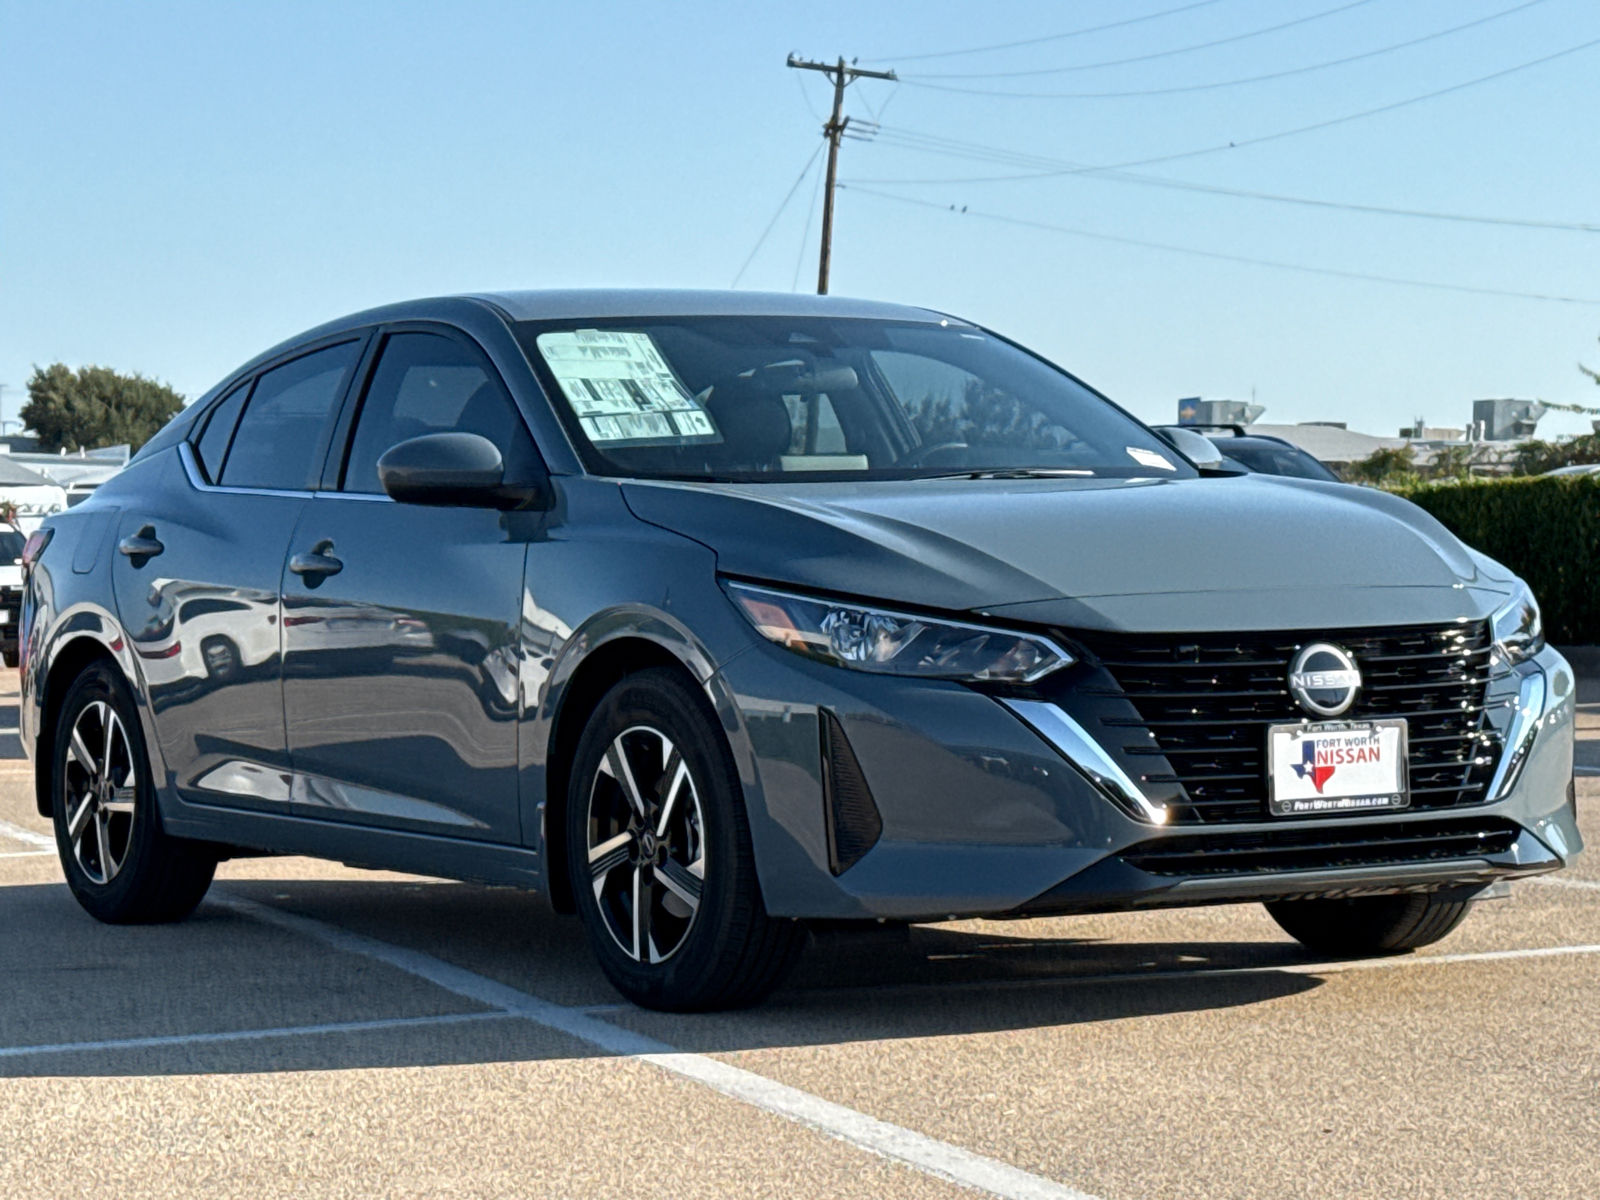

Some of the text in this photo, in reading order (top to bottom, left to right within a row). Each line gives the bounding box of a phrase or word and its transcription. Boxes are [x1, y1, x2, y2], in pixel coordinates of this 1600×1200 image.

[1292, 674, 1357, 687] NISSAN
[1316, 736, 1380, 748] FORT WORTH
[1316, 746, 1380, 765] NISSAN
